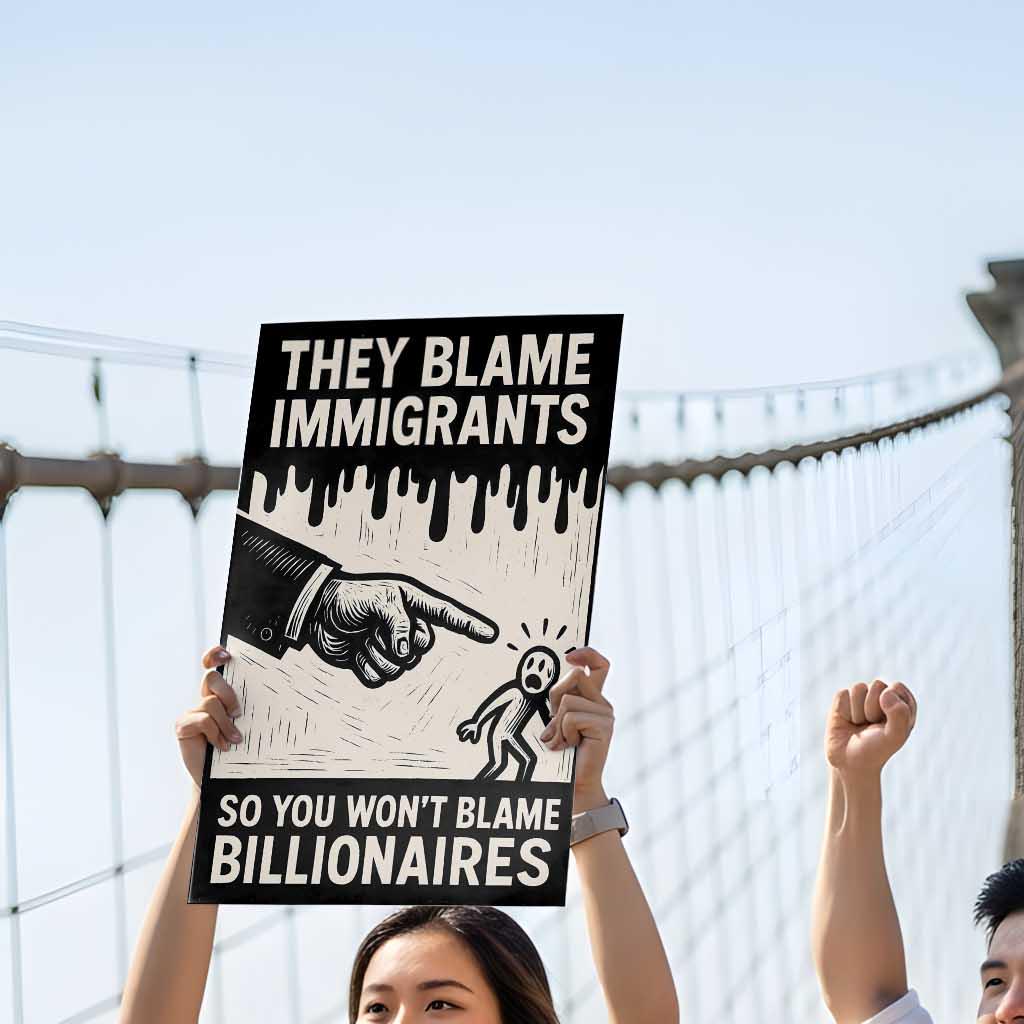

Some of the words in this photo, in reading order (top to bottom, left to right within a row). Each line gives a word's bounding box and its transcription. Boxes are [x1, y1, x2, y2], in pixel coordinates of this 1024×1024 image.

[281, 337, 410, 391] THEY
[420, 332, 595, 387] BLAME
[269, 393, 590, 448] IMMIGRANTS
[217, 794, 262, 828] SO
[272, 794, 336, 828] YOU
[347, 794, 449, 828] WON’T
[455, 796, 562, 831] BLAME
[210, 834, 552, 887] BILLIONAIRES
